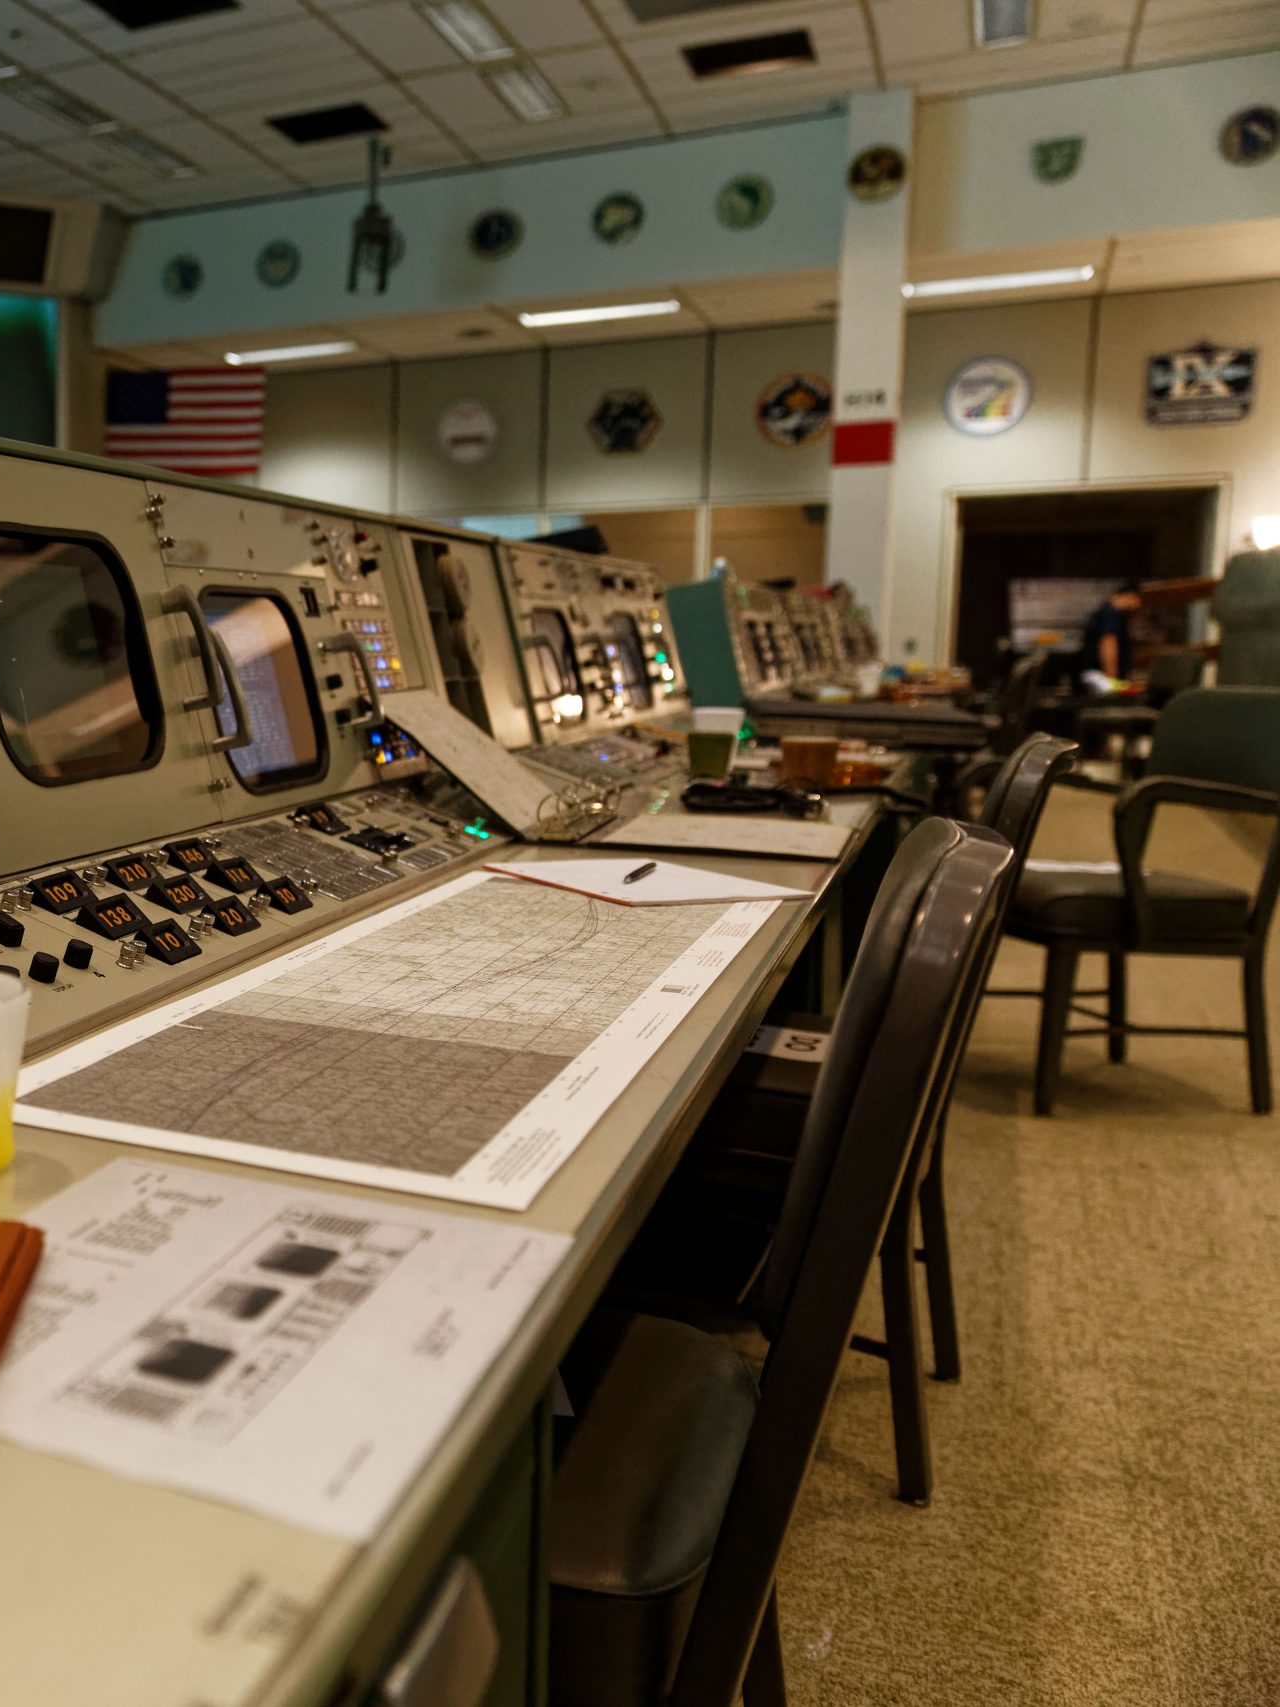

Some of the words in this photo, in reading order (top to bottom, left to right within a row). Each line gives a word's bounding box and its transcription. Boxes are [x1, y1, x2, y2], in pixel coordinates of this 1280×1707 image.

[118, 863, 148, 883] 210
[224, 866, 252, 883] 114
[44, 882, 79, 904] 109
[167, 884, 197, 905] 230
[98, 906, 133, 928] 138
[220, 908, 246, 927] 20
[154, 932, 182, 953] 10
